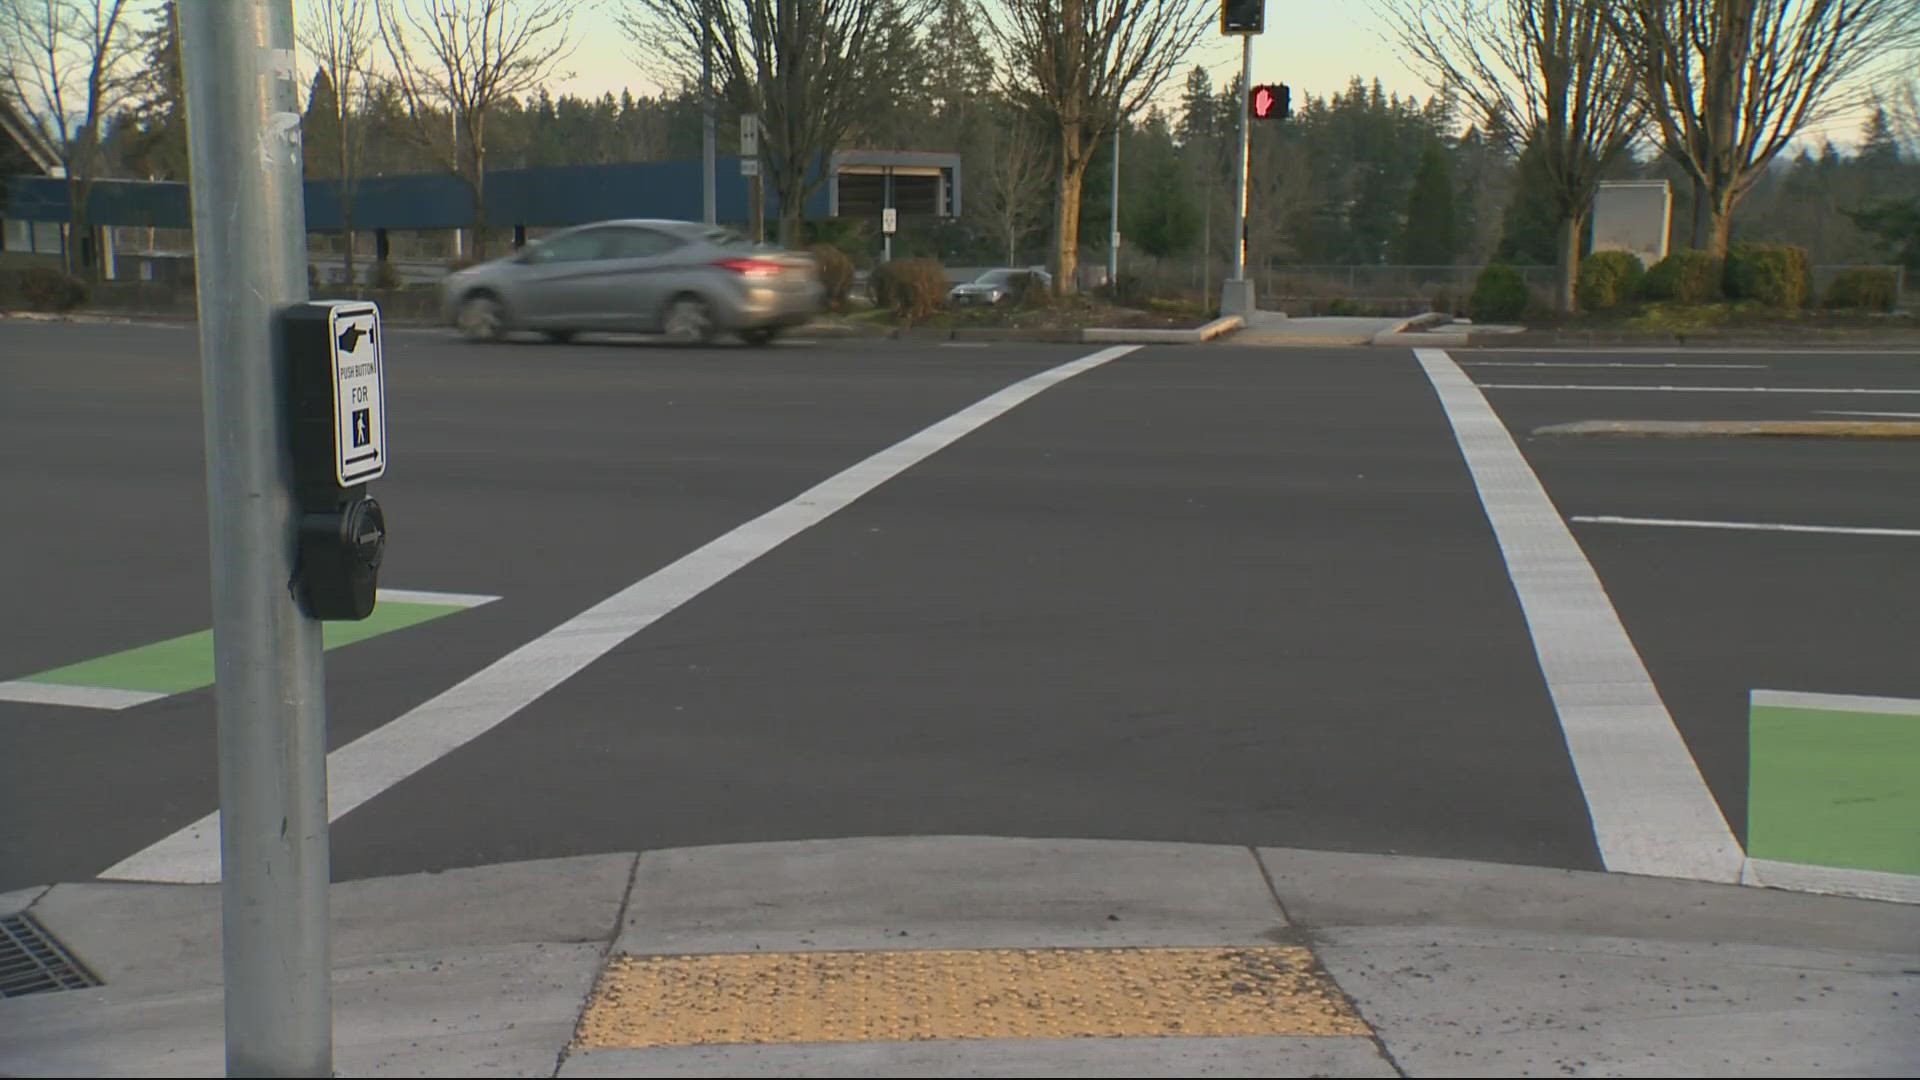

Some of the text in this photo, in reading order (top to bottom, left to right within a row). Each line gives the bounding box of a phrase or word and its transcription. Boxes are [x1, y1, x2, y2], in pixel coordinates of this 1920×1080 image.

[340, 362, 374, 380] PUSH BUTTON
[352, 385, 368, 404] FOR
